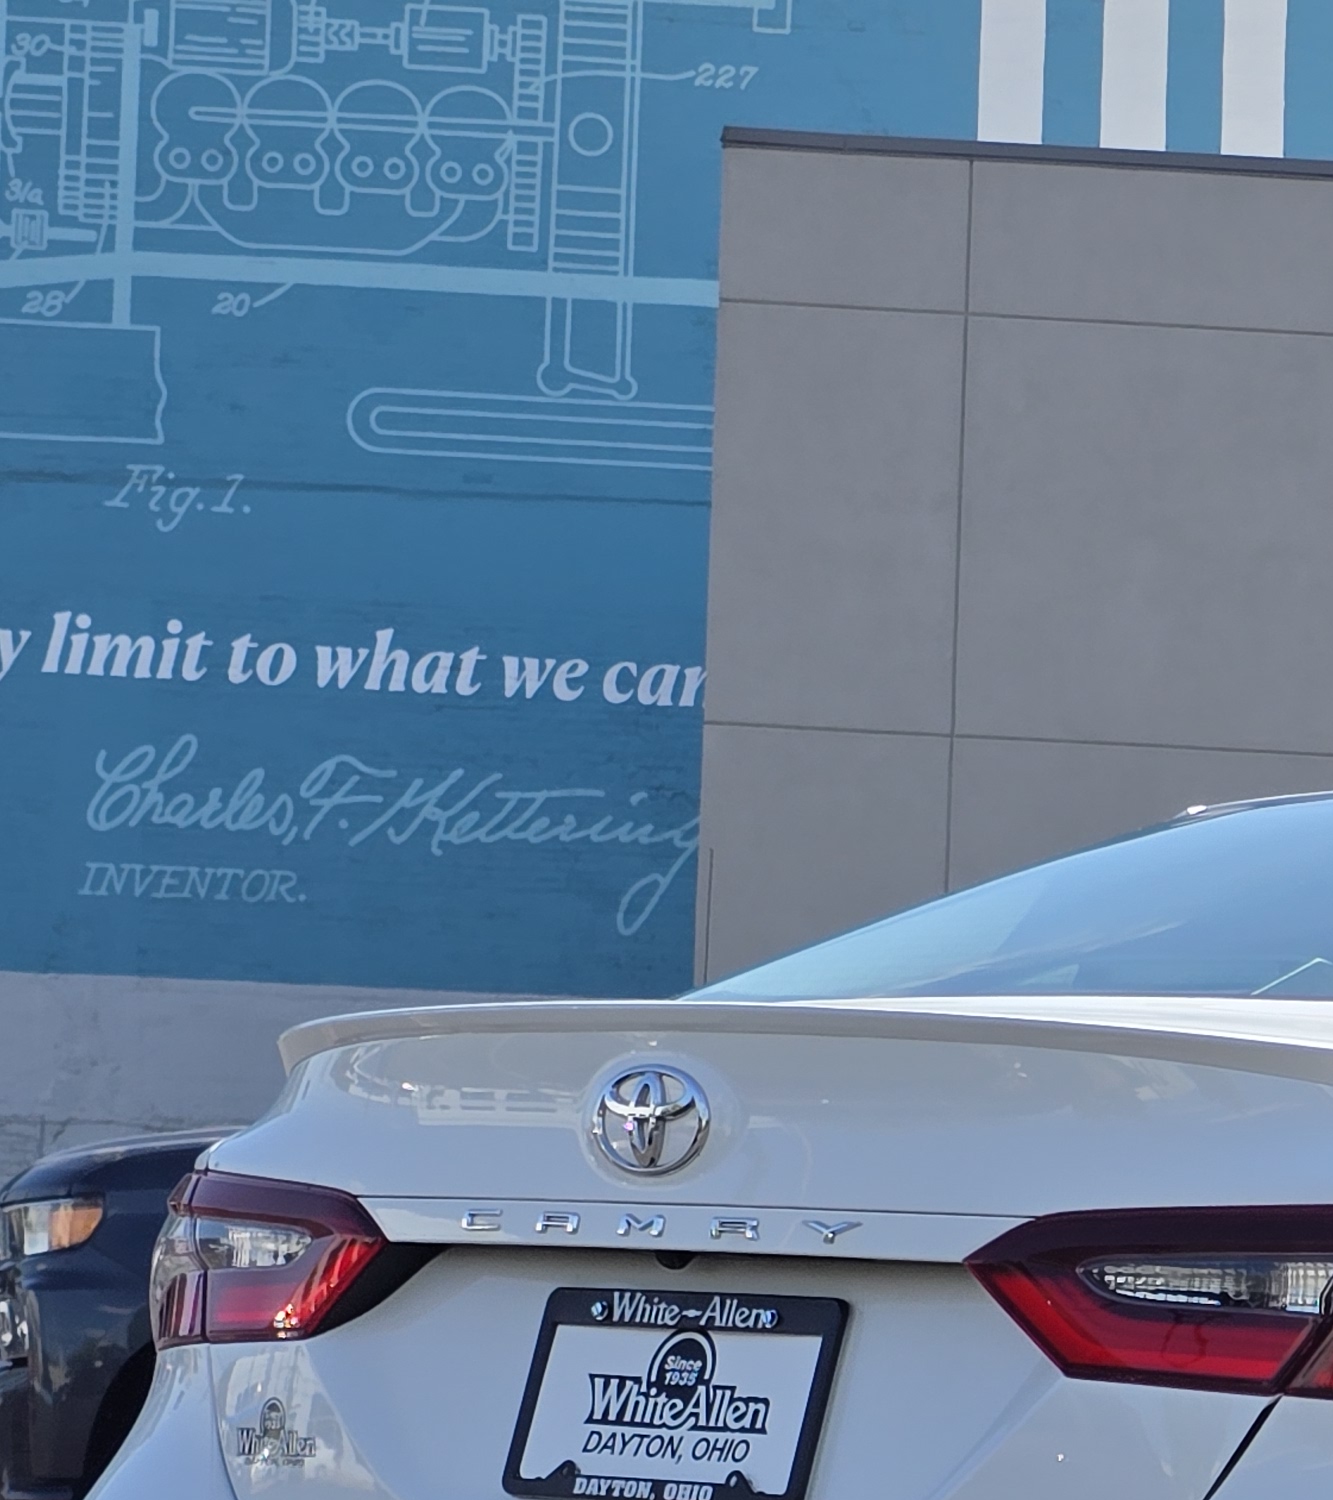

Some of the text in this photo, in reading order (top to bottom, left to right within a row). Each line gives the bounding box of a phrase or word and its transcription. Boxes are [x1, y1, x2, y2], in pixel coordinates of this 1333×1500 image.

[11, 33, 51, 57] 30
[694, 62, 759, 90] 227
[21, 290, 66, 317] 28
[211, 292, 251, 317] 20
[41, 611, 213, 681] limit
[228, 633, 297, 686] to
[315, 627, 487, 696] what
[502, 655, 589, 702] we
[78, 860, 307, 903] INVENTOR.
[462, 1208, 862, 1244] CAMRY
[664, 1355, 702, 1371] Since
[664, 1371, 699, 1386] 1935
[582, 1430, 750, 1465] DAYTON, OHIO
[573, 1476, 656, 1500] DAYTON,
